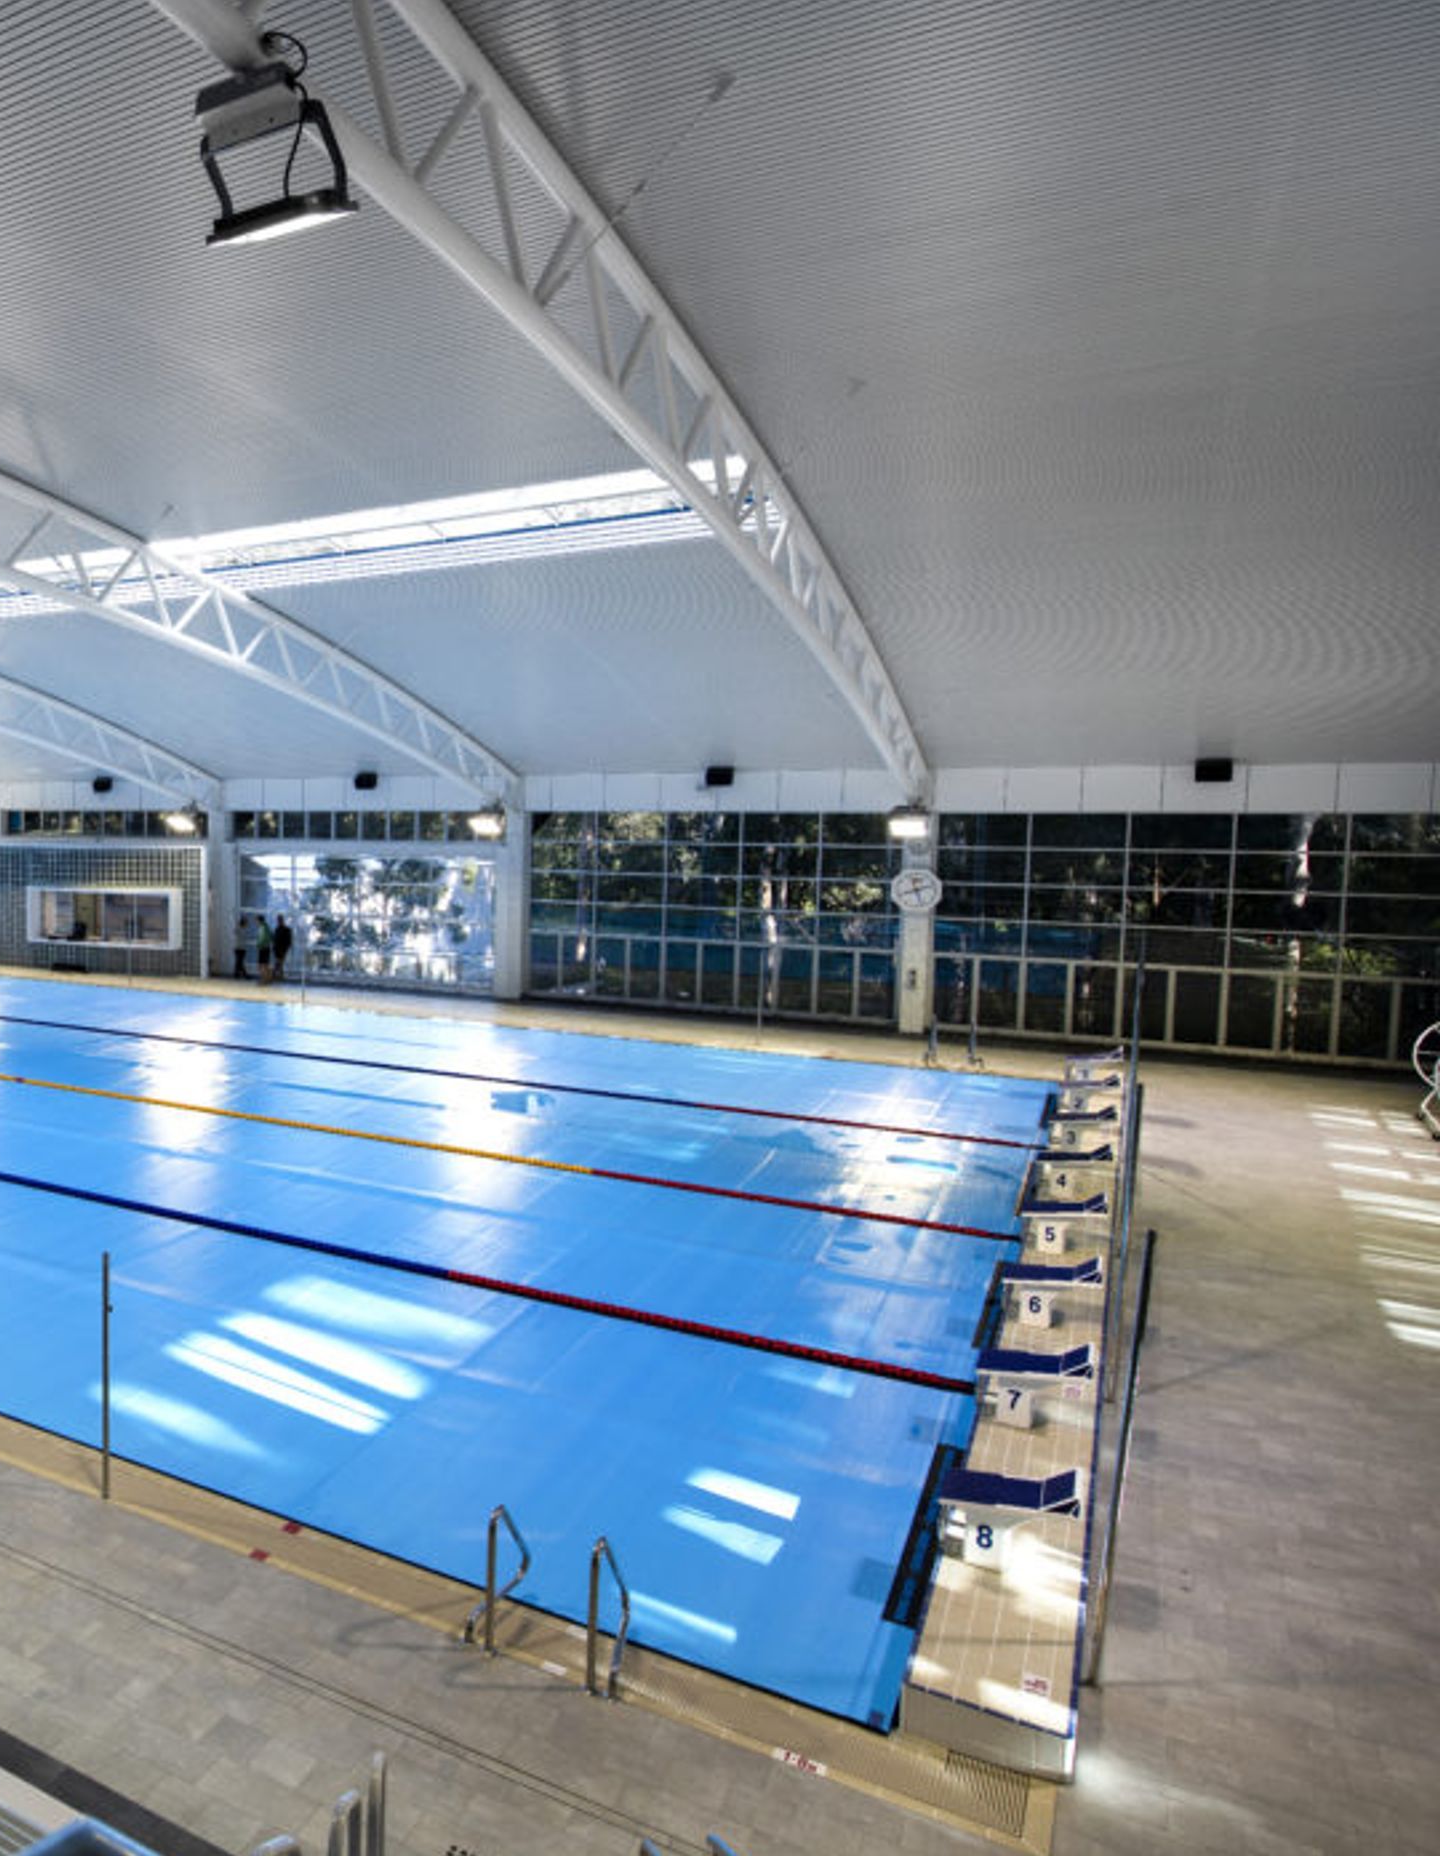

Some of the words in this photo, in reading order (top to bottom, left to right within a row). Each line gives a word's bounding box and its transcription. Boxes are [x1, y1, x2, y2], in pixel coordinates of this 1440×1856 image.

[1066, 1130, 1077, 1145] 3
[1056, 1173, 1067, 1188] 4
[1045, 1226, 1056, 1242] 5
[1028, 1296, 1042, 1314] 6
[1007, 1389, 1022, 1410] 7
[975, 1524, 993, 1550] 8
